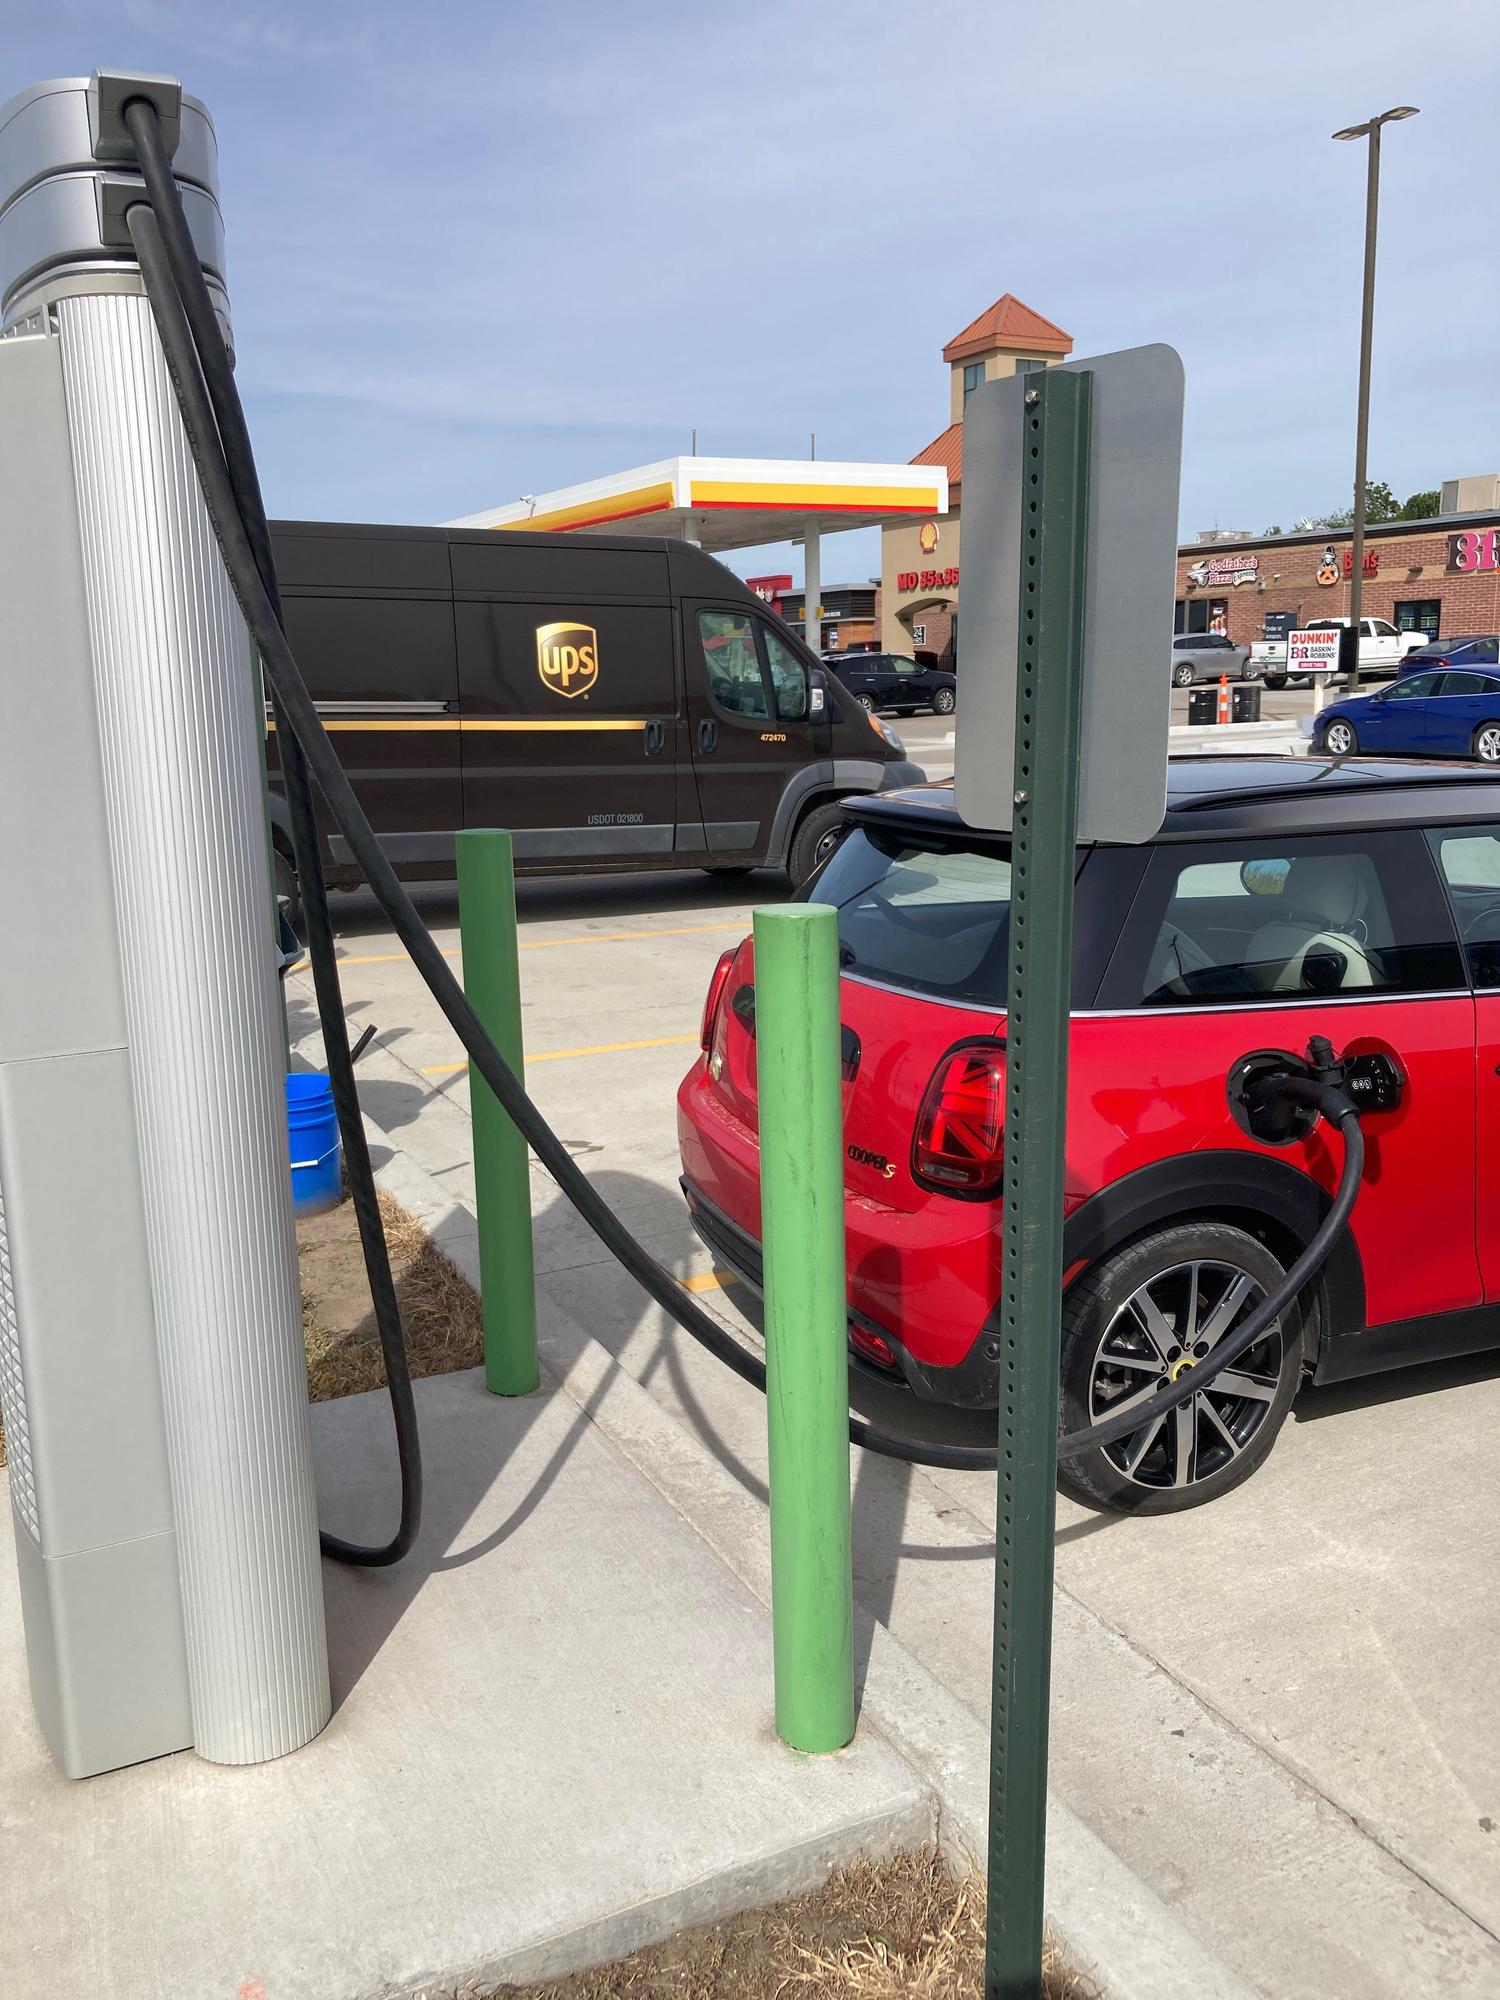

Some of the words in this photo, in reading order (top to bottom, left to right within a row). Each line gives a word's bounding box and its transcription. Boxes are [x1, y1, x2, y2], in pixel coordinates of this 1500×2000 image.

[1209, 556, 1258, 571] Godfather's
[1344, 551, 1378, 569] Bn's
[897, 572, 918, 590] MO
[1209, 572, 1232, 584] Pizza
[1233, 570, 1255, 582] Express
[1291, 633, 1337, 645] DUNKIN'
[1290, 646, 1309, 659] BR
[543, 646, 594, 686] ups
[760, 733, 787, 742] 472470
[587, 814, 615, 824] USDOT
[617, 813, 644, 823] 021800
[848, 1144, 887, 1171] COOPER
